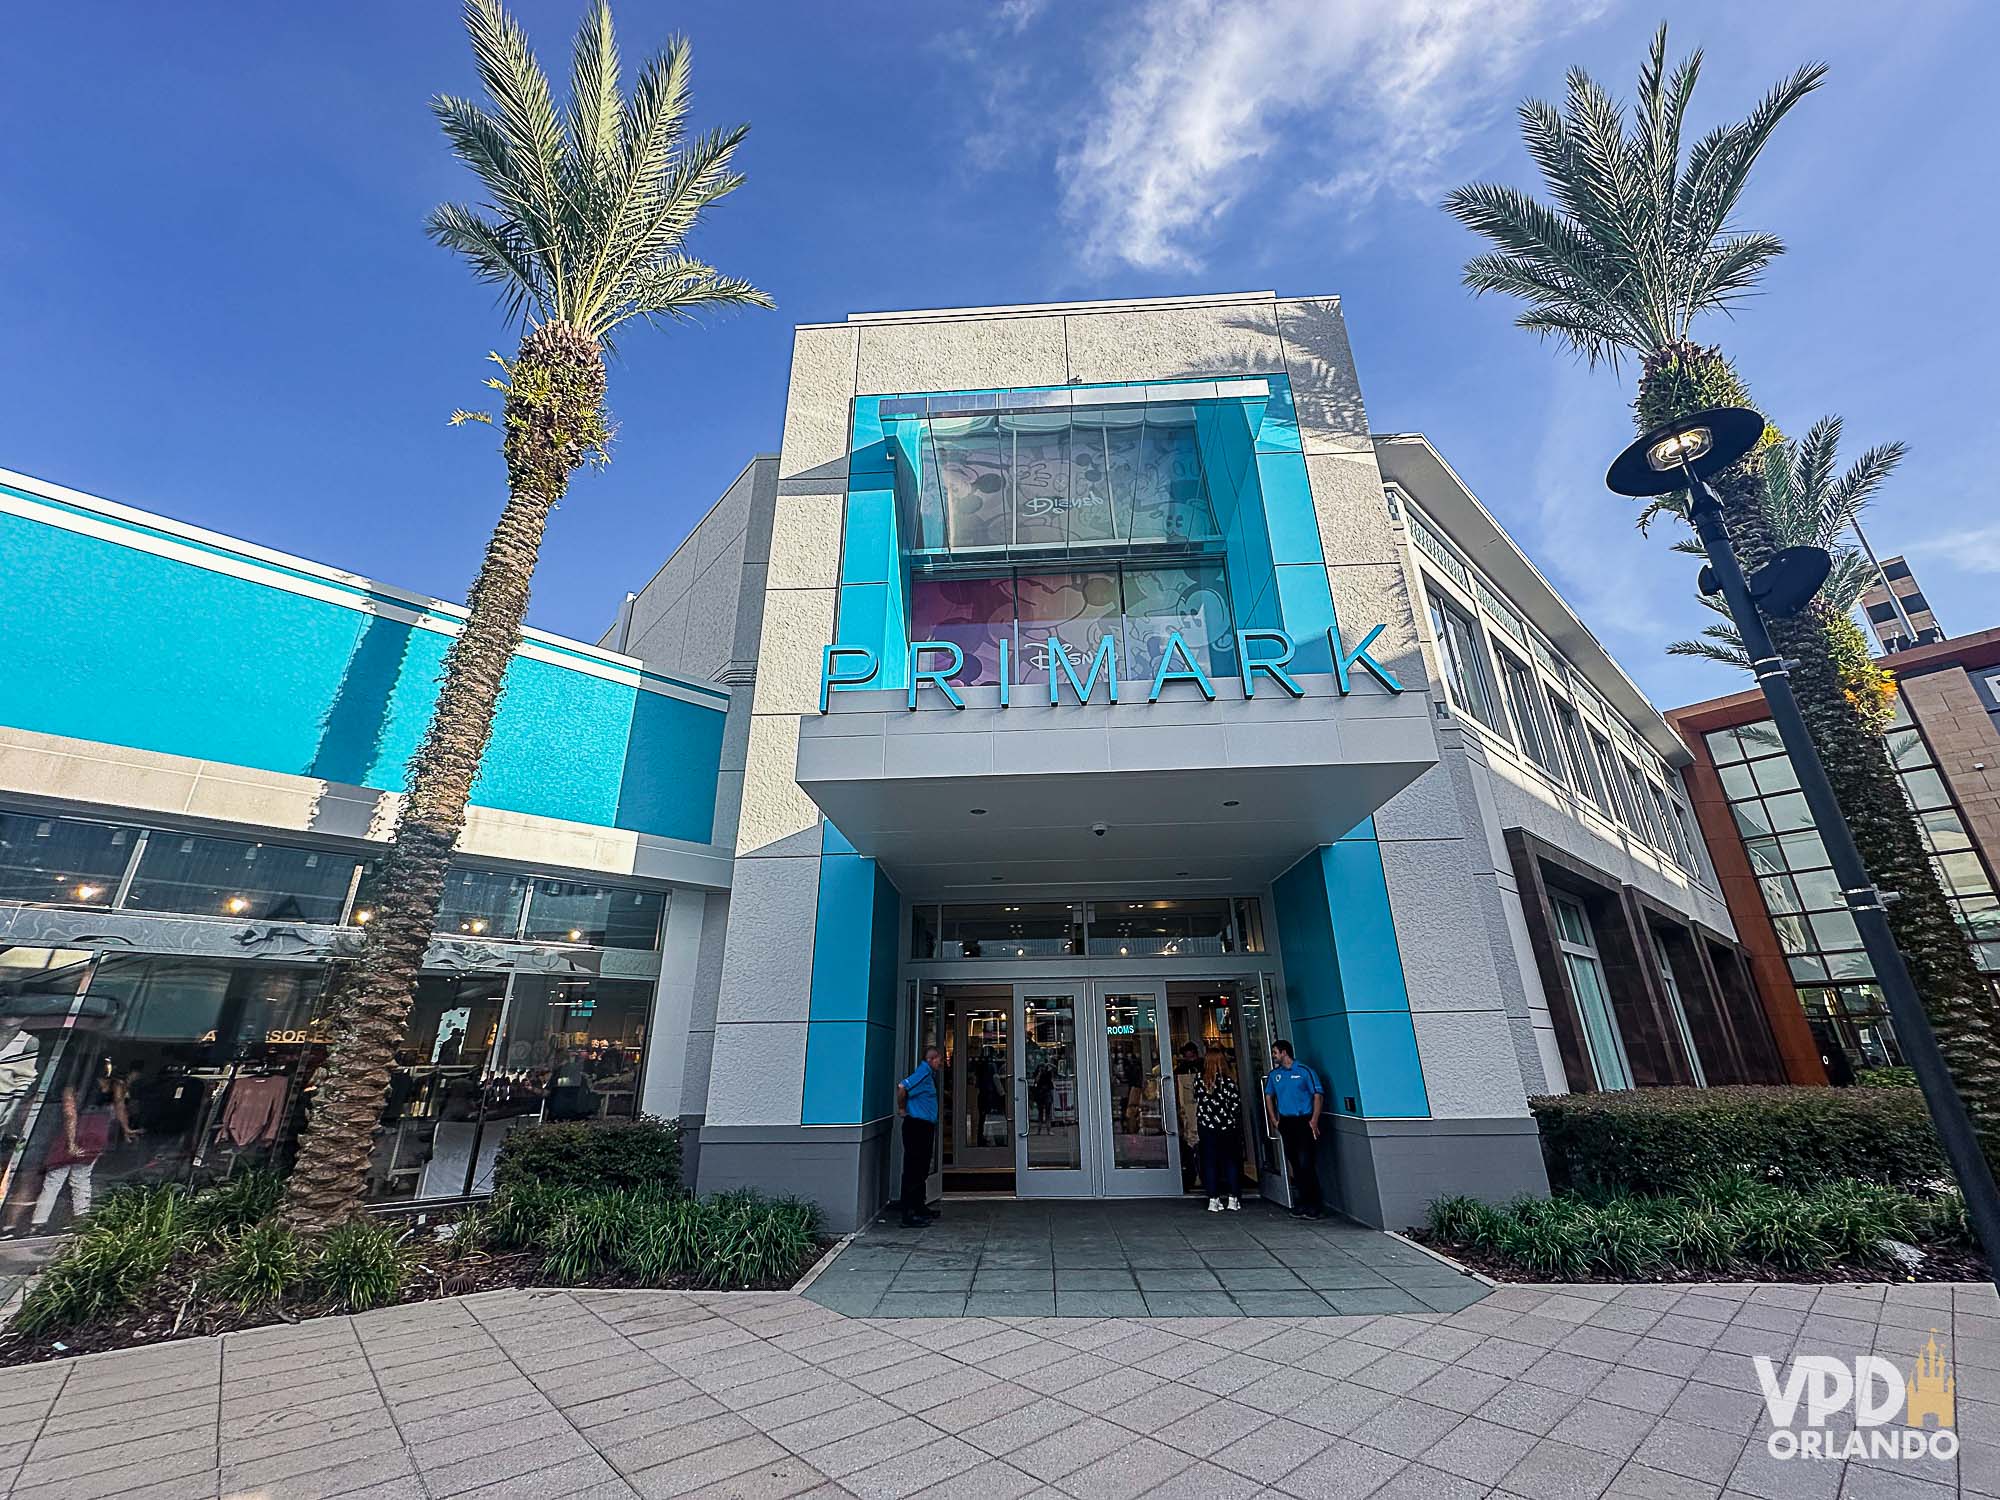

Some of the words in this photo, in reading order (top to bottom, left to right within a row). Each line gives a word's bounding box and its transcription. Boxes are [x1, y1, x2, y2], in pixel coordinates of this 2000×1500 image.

[1022, 491, 1104, 517] Disney
[819, 624, 1404, 714] PRIMARK
[1107, 1025, 1135, 1035] ROOMS
